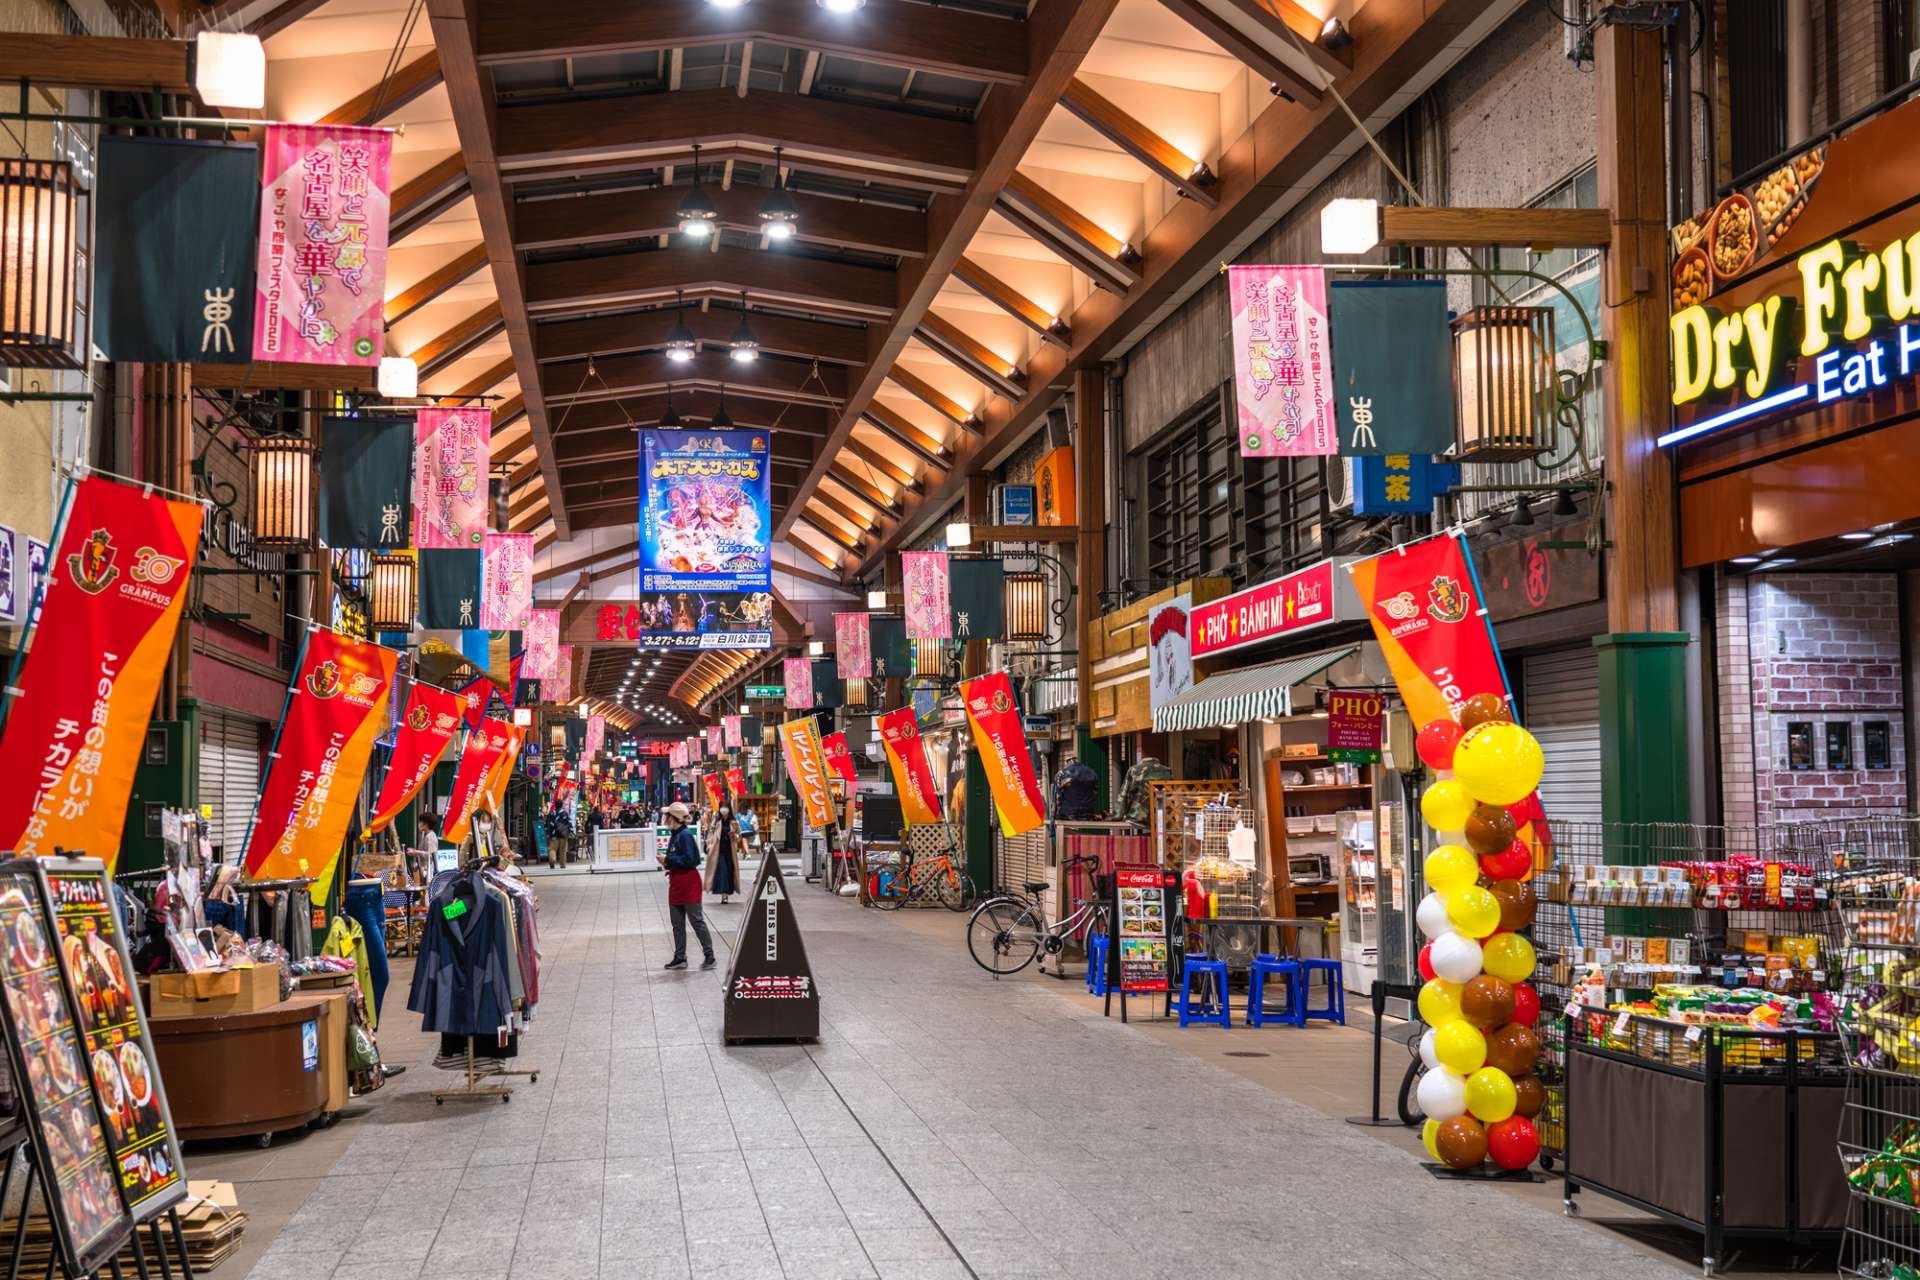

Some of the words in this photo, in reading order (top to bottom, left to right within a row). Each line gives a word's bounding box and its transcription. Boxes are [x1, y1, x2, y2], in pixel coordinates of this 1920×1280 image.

[295, 150, 337, 338] 名古屋を華やかに
[1670, 296, 1781, 406] Dry
[1816, 340, 1887, 403] Eat
[119, 583, 171, 606] GRAMPUS
[1240, 596, 1269, 637] BÁNH
[60, 652, 118, 820] この街の想いが
[20, 718, 80, 858] チカラになる
[279, 770, 314, 855] チカラになる
[303, 732, 345, 829] この街の想いが
[768, 902, 776, 928] THIS
[768, 934, 776, 959] WAY
[734, 991, 810, 999] OSUKANNON
